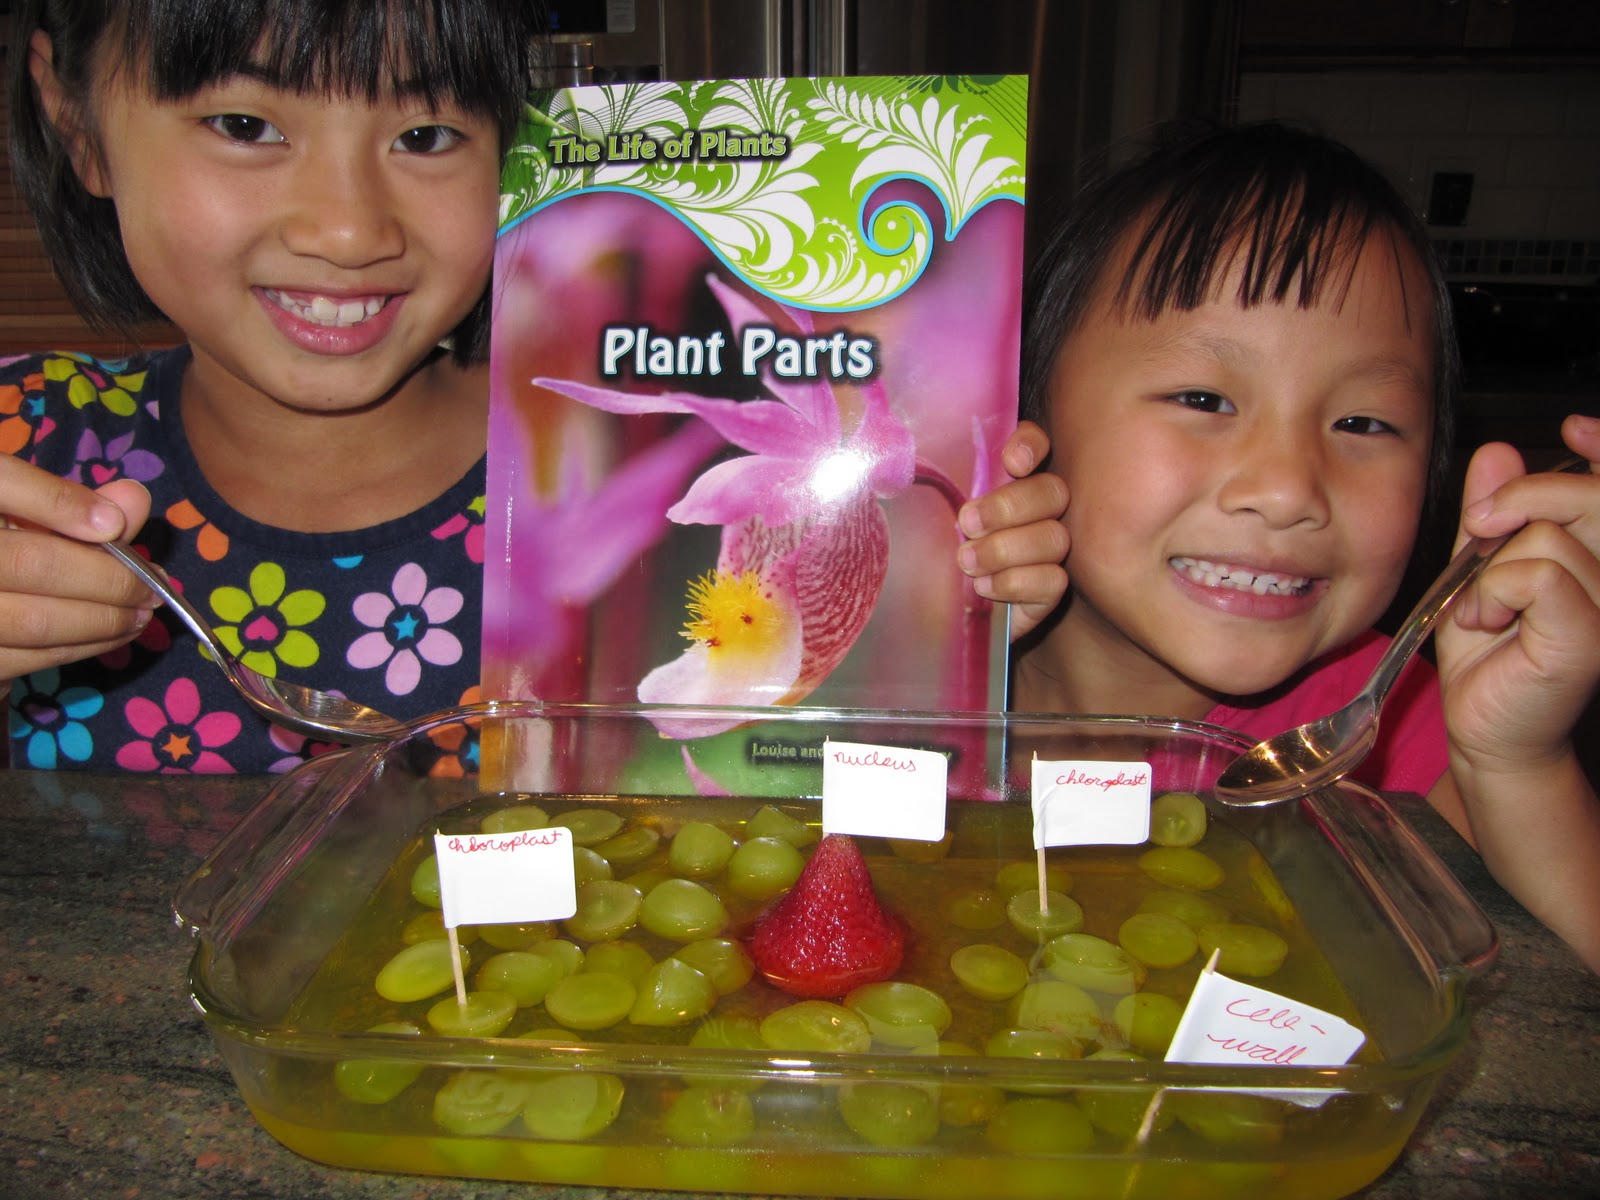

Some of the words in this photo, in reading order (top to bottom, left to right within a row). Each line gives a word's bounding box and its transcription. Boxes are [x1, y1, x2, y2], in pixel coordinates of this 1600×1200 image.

[549, 137, 600, 163] The
[607, 132, 656, 160] Life
[663, 131, 694, 158] of
[699, 129, 787, 157] Plants
[603, 327, 725, 375] Plant
[742, 327, 873, 378] Parts
[752, 743, 797, 757] Louise
[833, 751, 916, 772] nucleus
[1056, 769, 1147, 792] chloroplast
